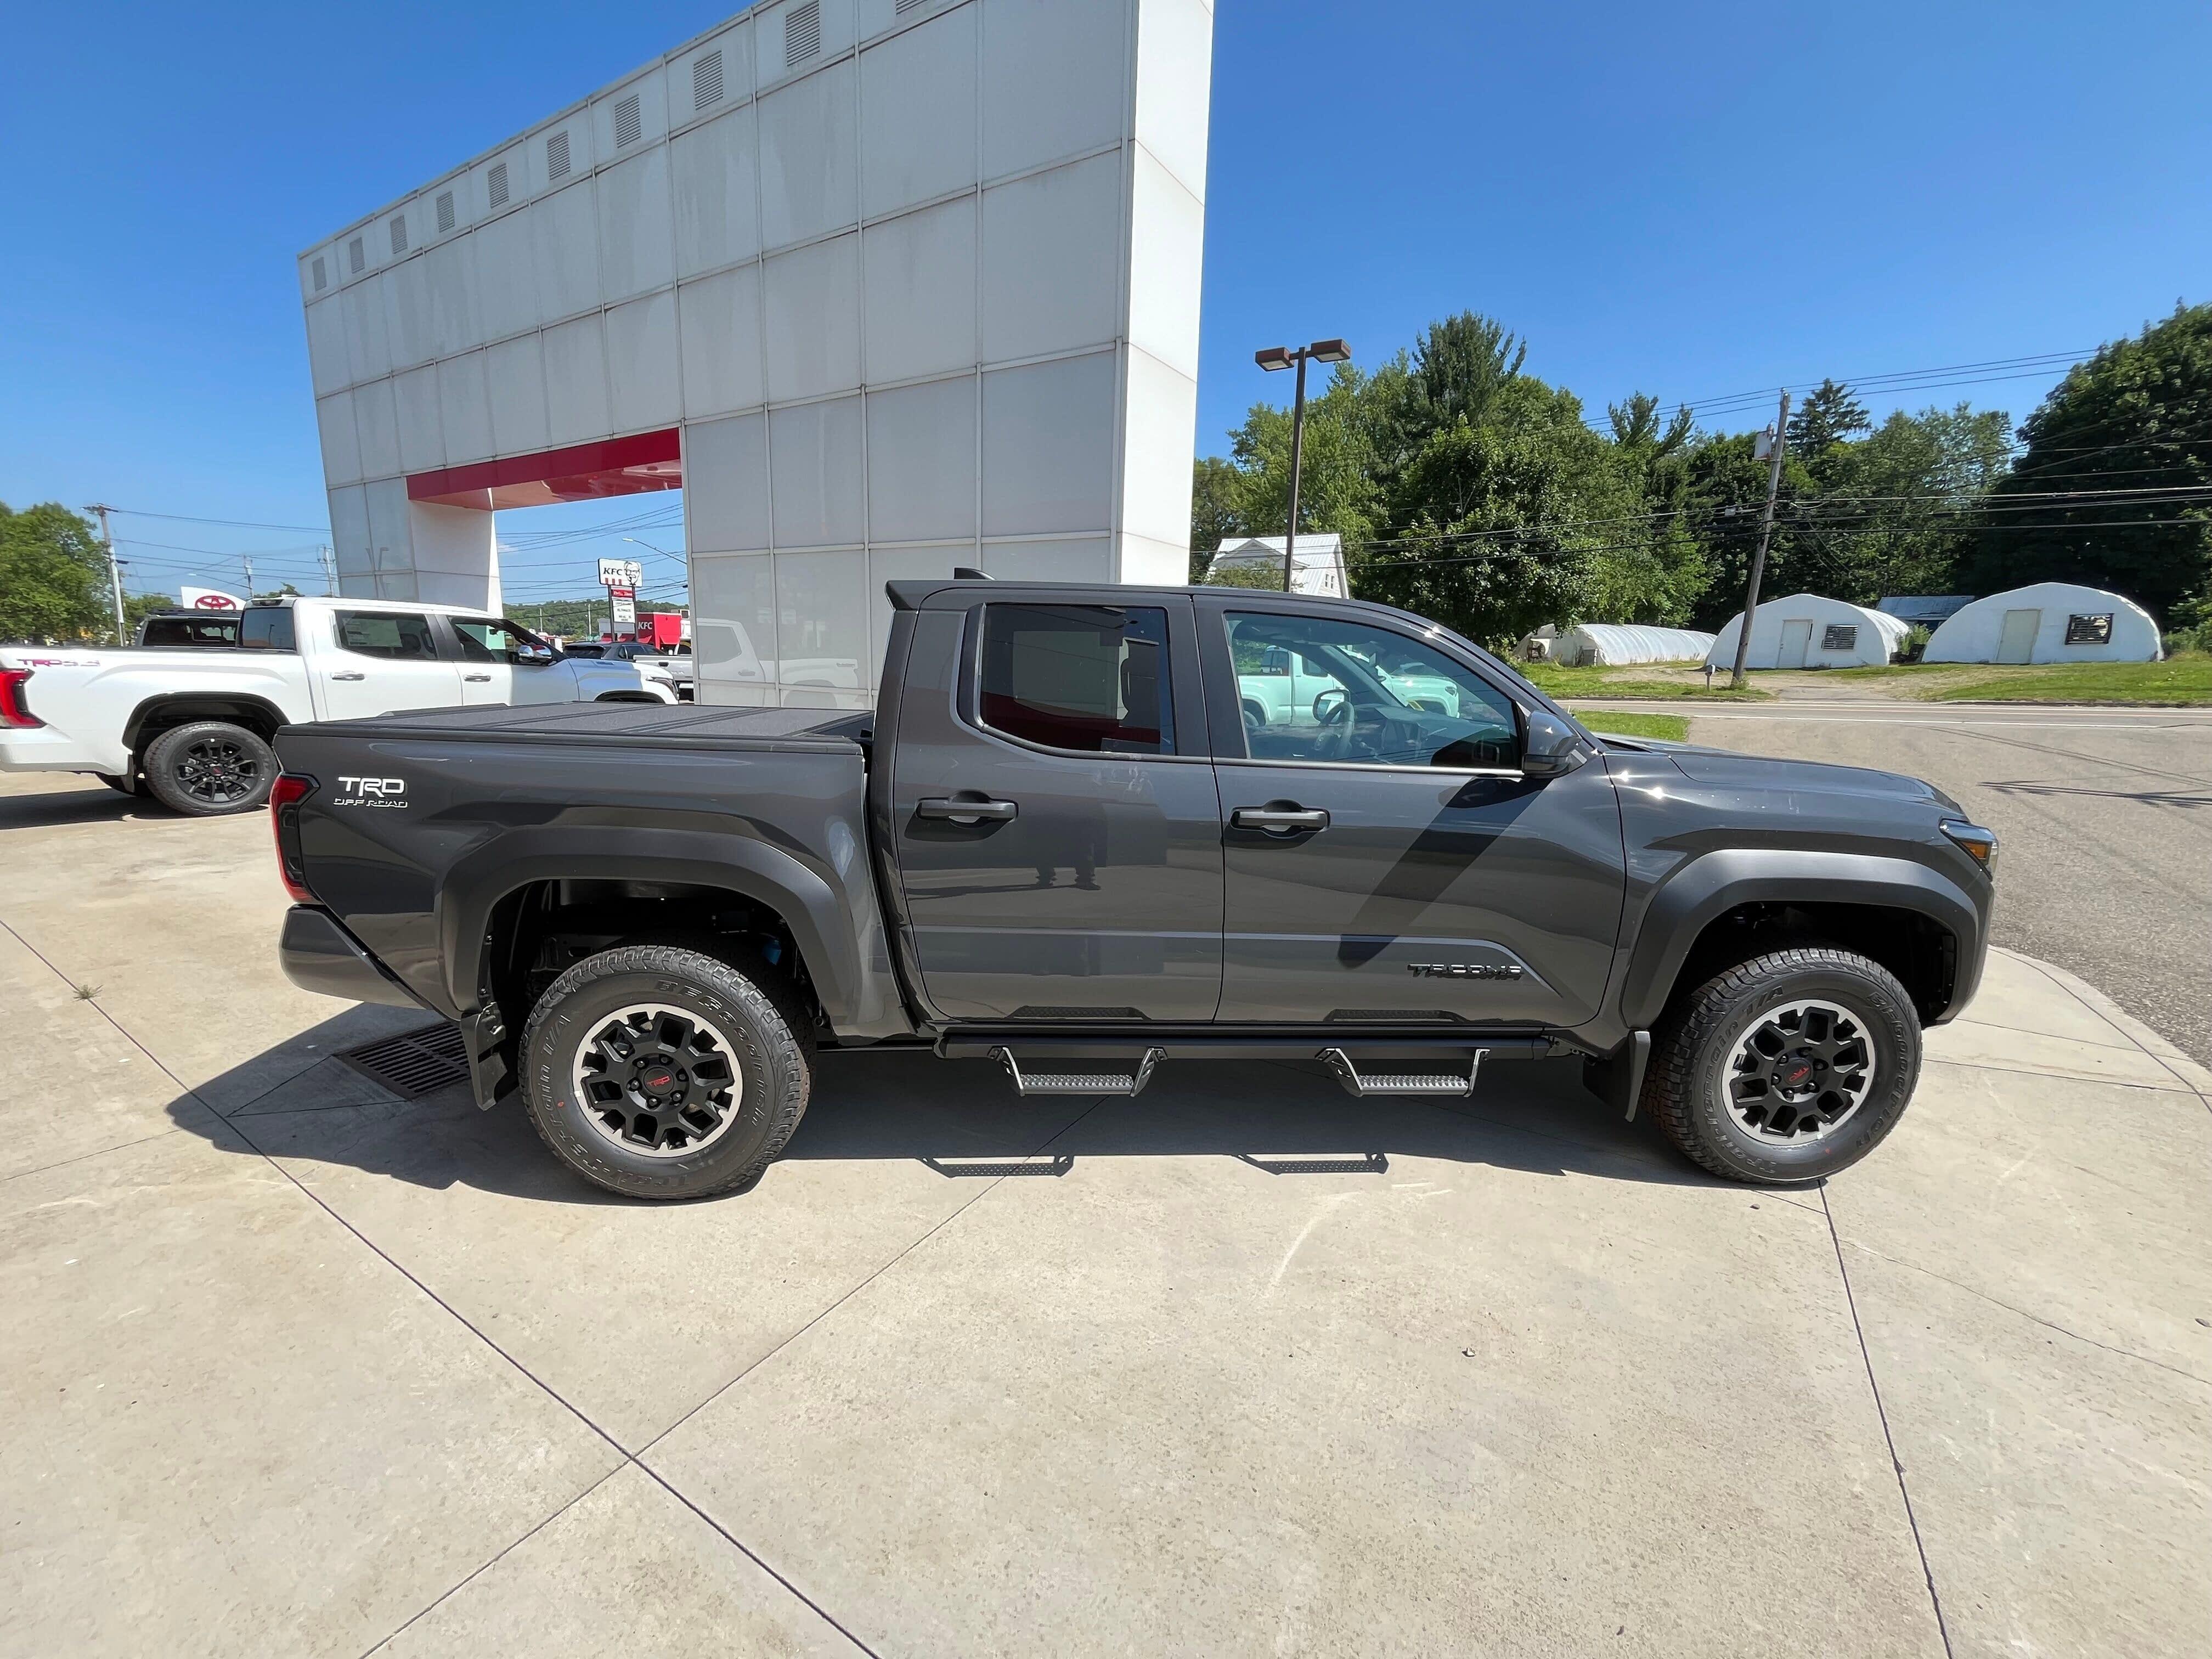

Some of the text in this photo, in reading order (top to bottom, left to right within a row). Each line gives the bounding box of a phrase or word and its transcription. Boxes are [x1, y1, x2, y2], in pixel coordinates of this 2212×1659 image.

[603, 567, 623, 575] KFC
[638, 622, 653, 630] KFC
[338, 776, 405, 798] TRD
[366, 800, 408, 808] ROAD
[646, 1075, 670, 1087] TRD
